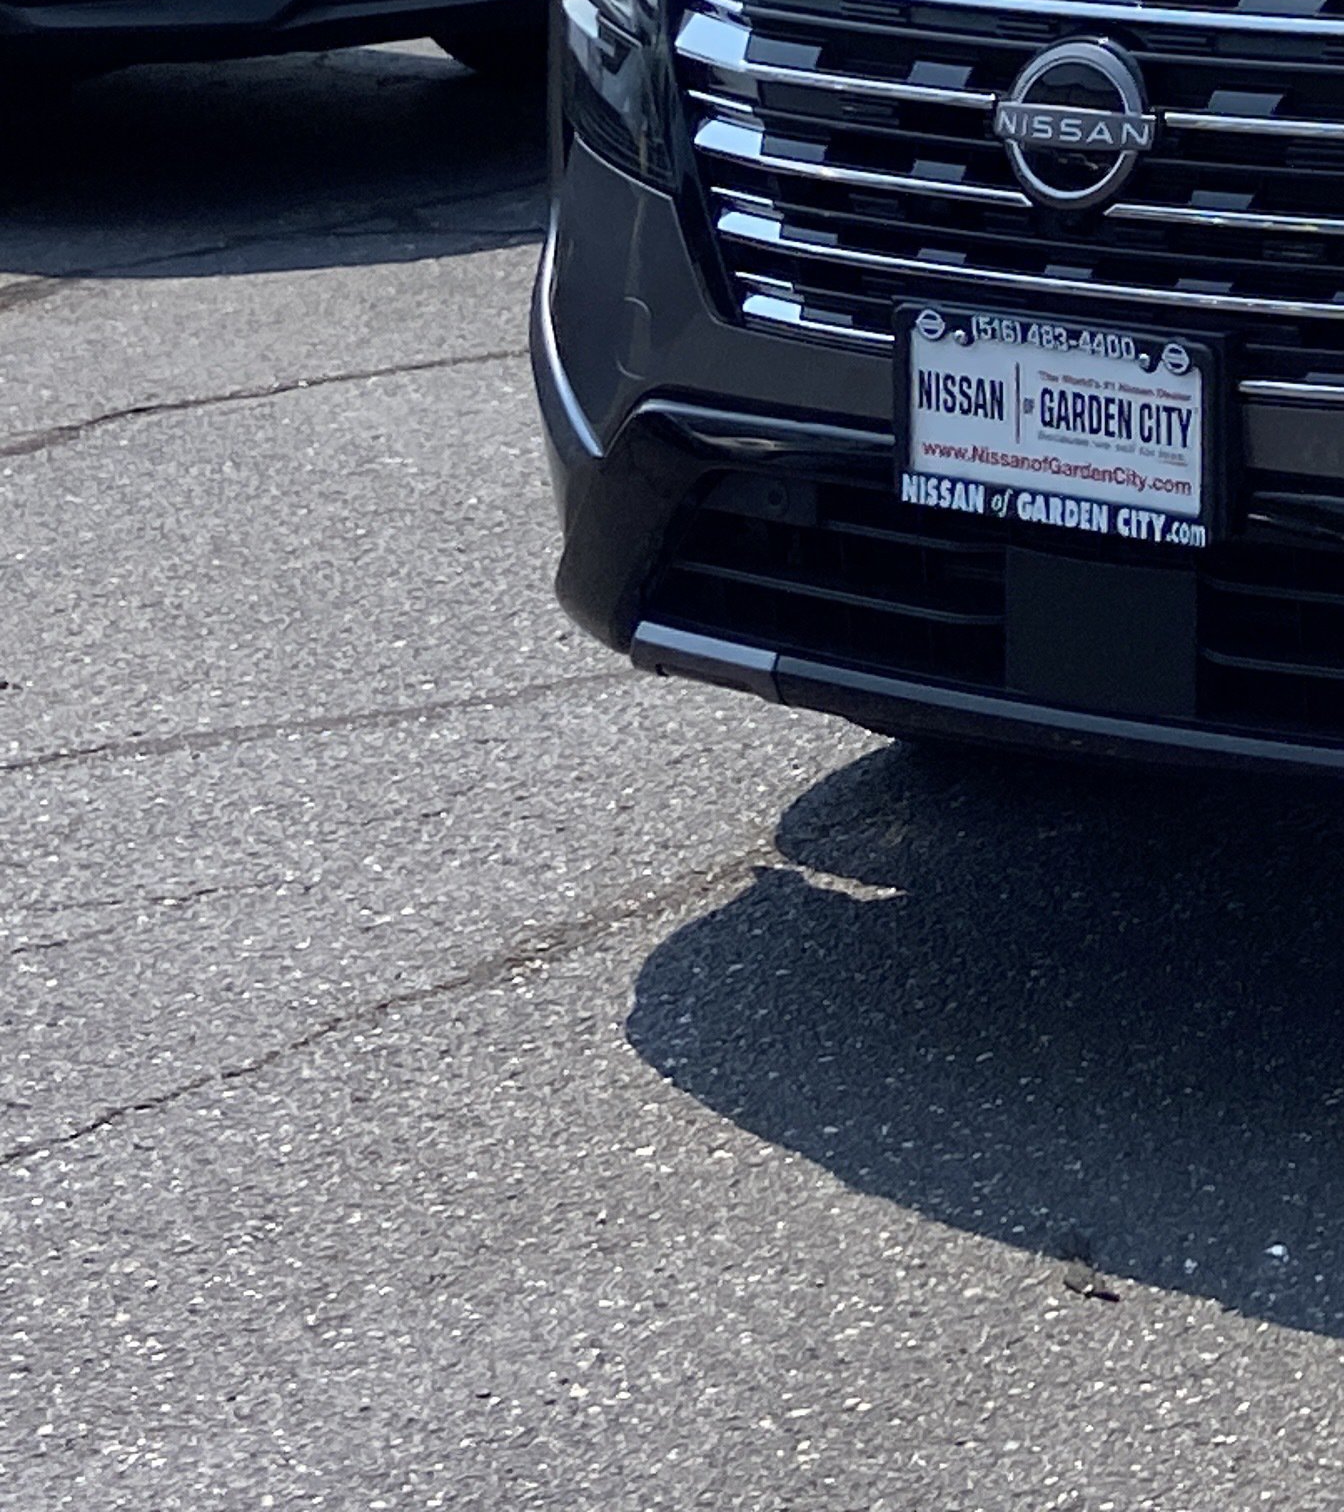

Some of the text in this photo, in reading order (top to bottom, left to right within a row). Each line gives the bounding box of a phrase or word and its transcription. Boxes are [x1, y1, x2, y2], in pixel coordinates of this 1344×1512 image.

[998, 110, 1149, 146] NISSAN
[971, 315, 1136, 361] (516) 483-4400
[917, 369, 1005, 422] NISSAN
[1040, 387, 1133, 440] GARDEN
[1139, 402, 1193, 449] CITY
[921, 441, 1193, 497] www.NissanofGardenCity.com
[901, 473, 1207, 548] NISSAN of GARDEN CITY.com
